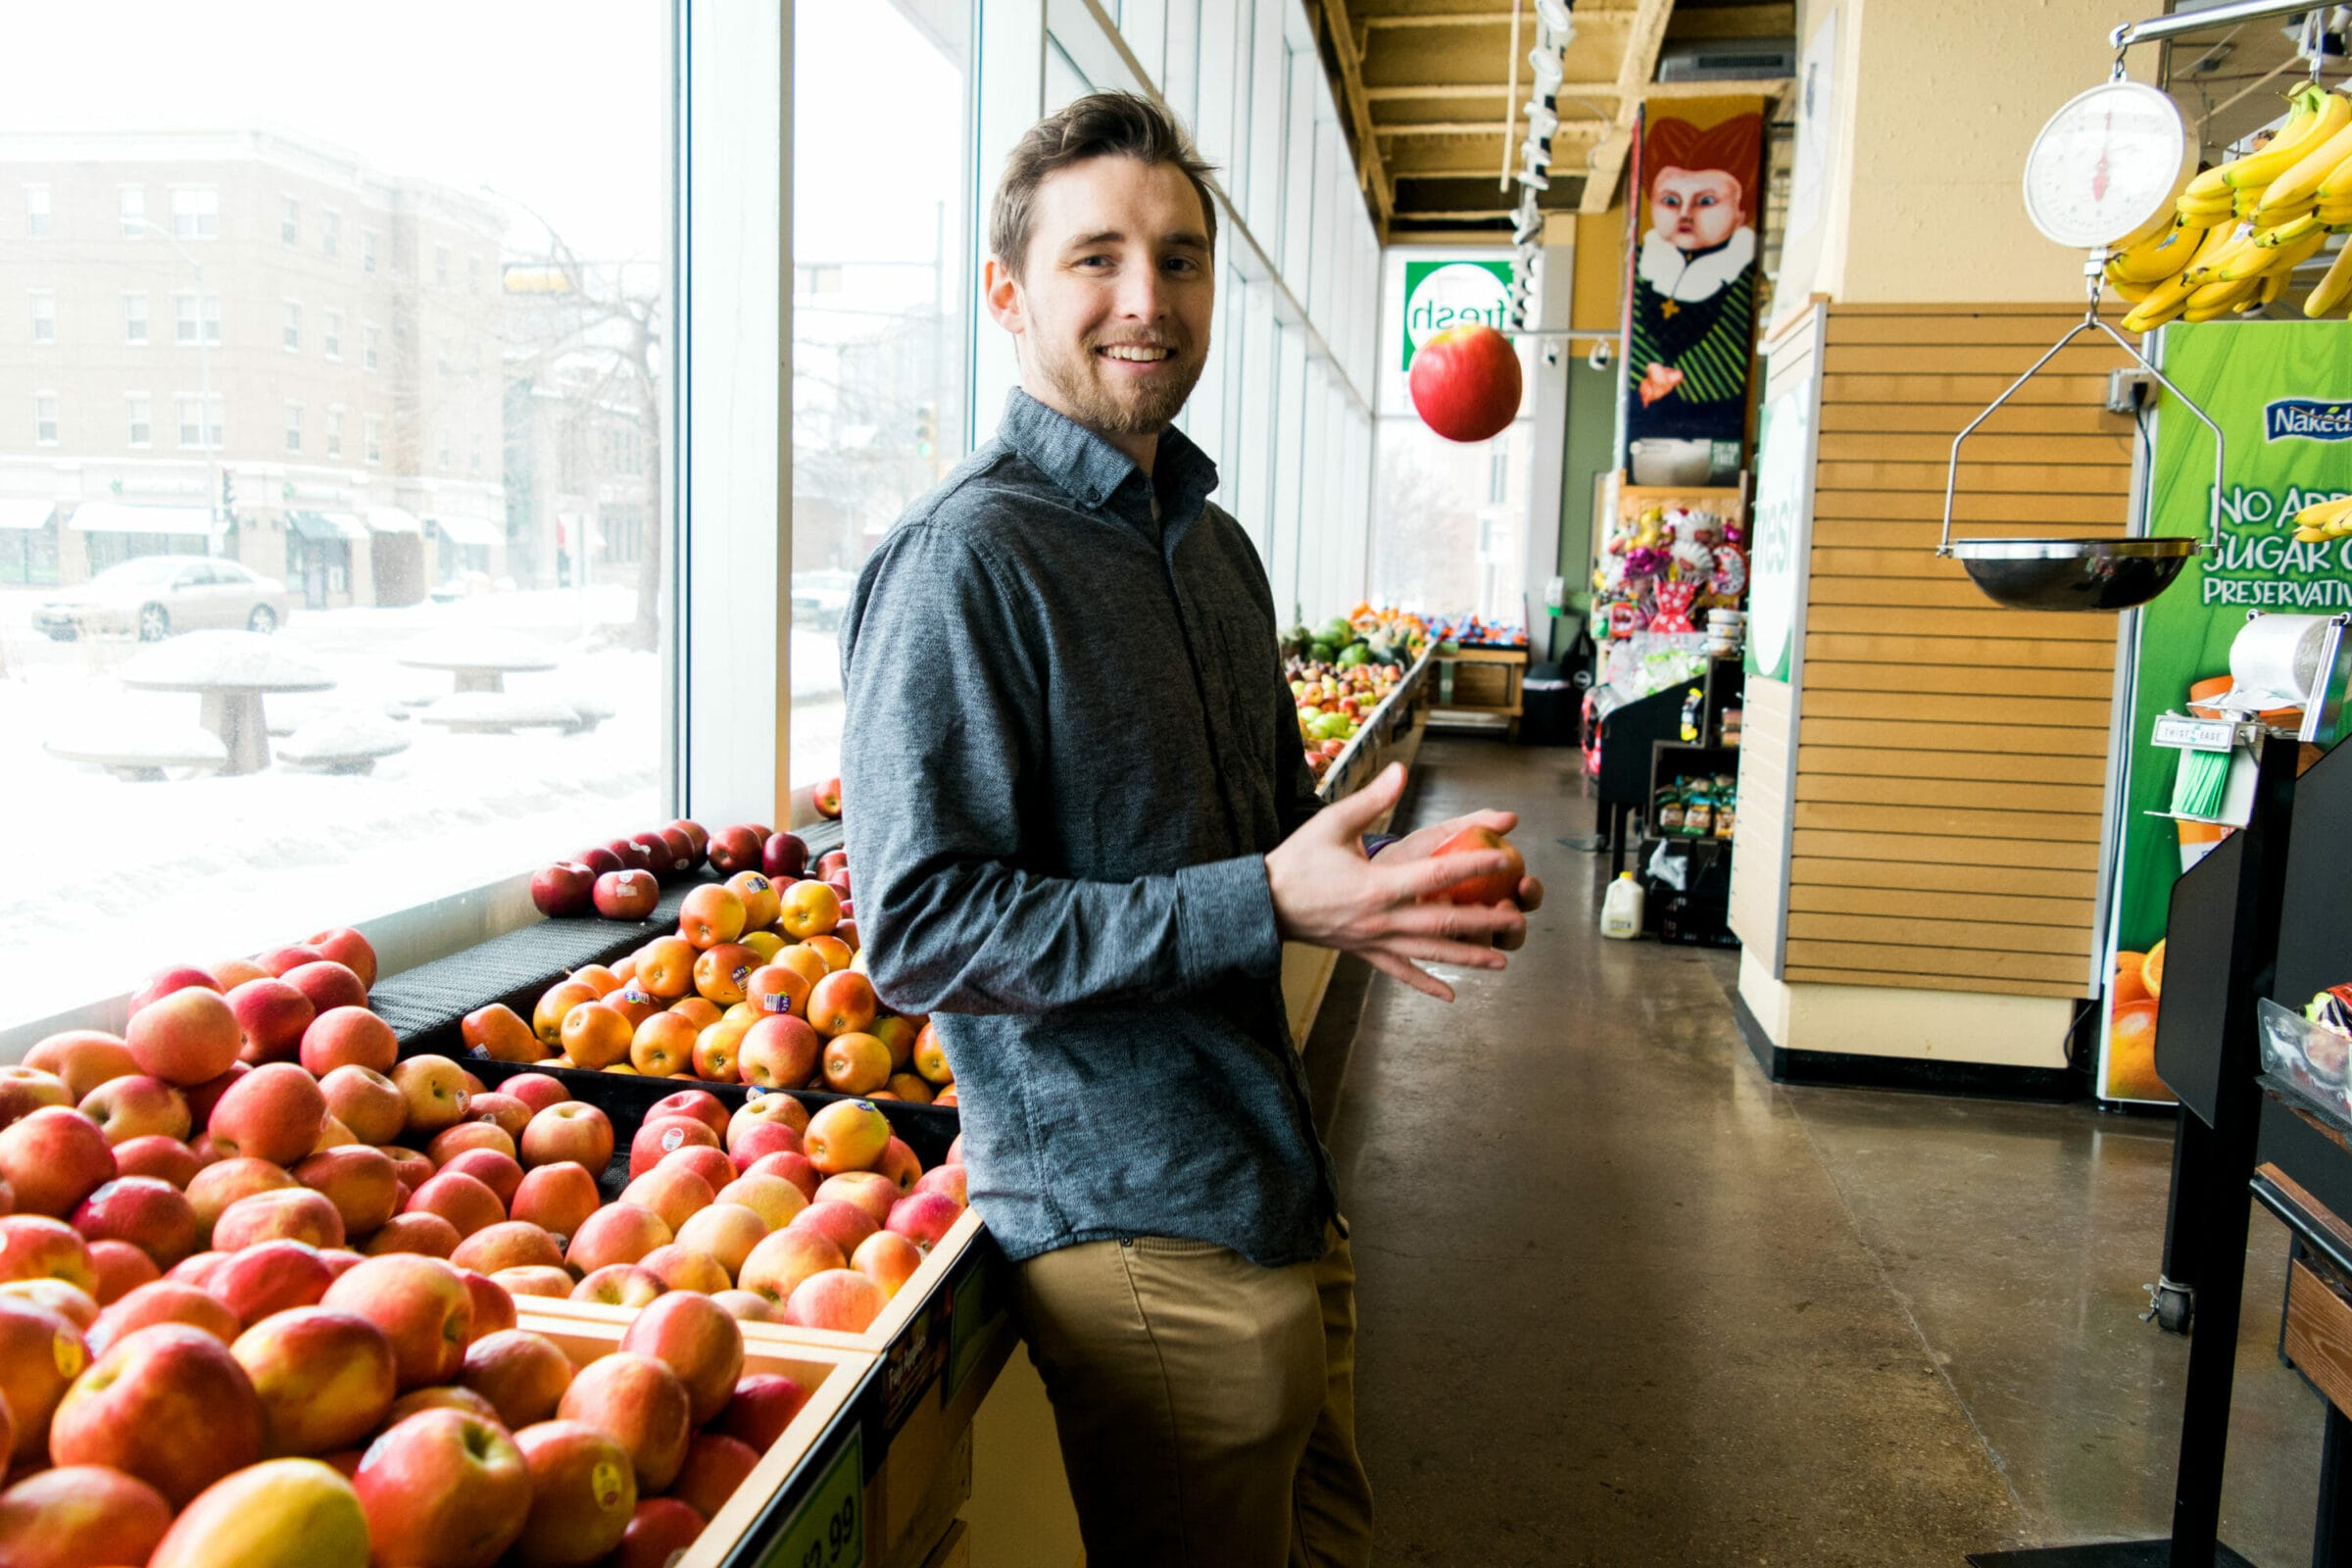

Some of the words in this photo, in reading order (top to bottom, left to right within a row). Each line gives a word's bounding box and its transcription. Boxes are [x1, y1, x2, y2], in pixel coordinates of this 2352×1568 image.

[2275, 406, 2350, 433] Naked
[2210, 486, 2272, 527] NO
[2202, 532, 2331, 574] SUGAR
